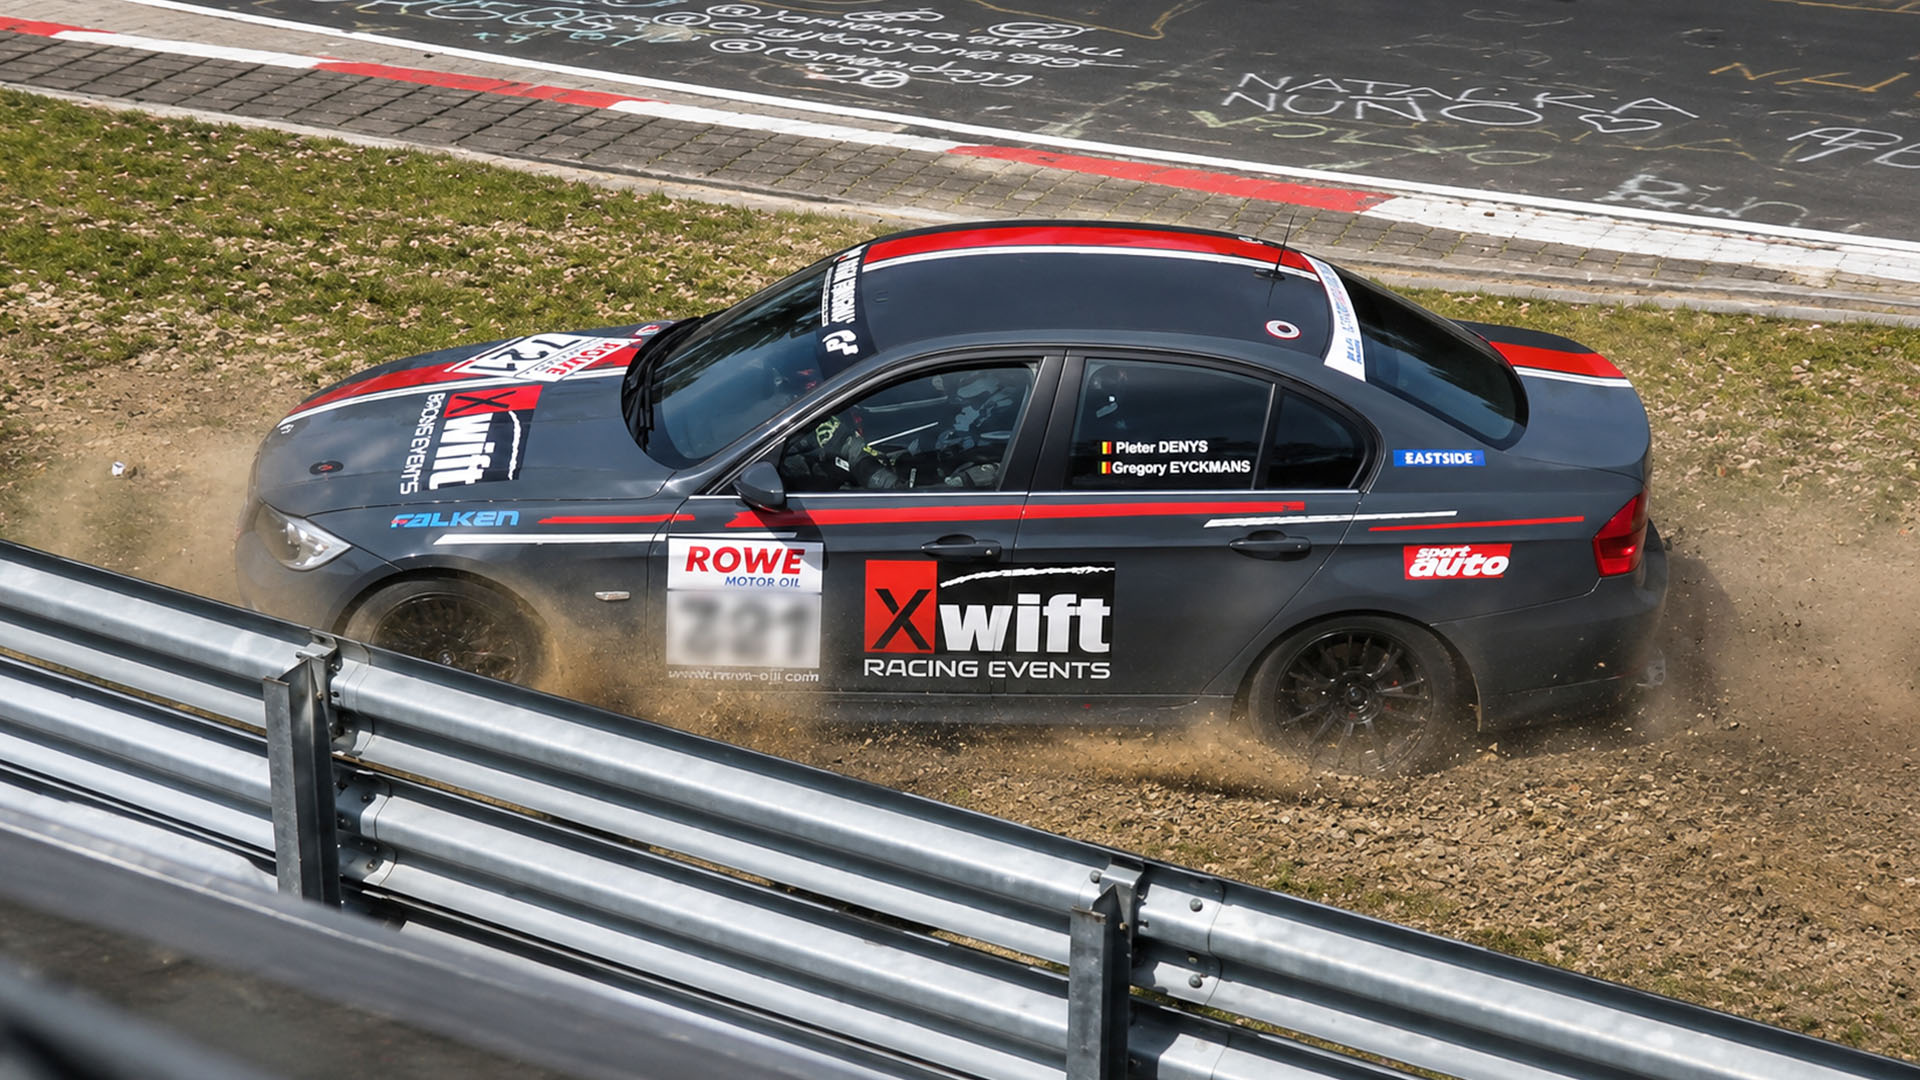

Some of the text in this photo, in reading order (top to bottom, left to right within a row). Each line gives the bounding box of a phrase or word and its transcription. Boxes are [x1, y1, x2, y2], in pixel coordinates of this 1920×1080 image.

[1159, 440, 1208, 453] DENYS
[1404, 452, 1474, 465] EASTSIDE
[1112, 460, 1251, 476] Gregory EYCKMANS
[390, 510, 520, 528] FALKEN
[685, 546, 806, 575] ROWE
[1416, 545, 1471, 562] sport
[1409, 554, 1510, 578] auto
[724, 576, 801, 588] MOTOR OIL
[864, 659, 1111, 680] RACING EVENTS
